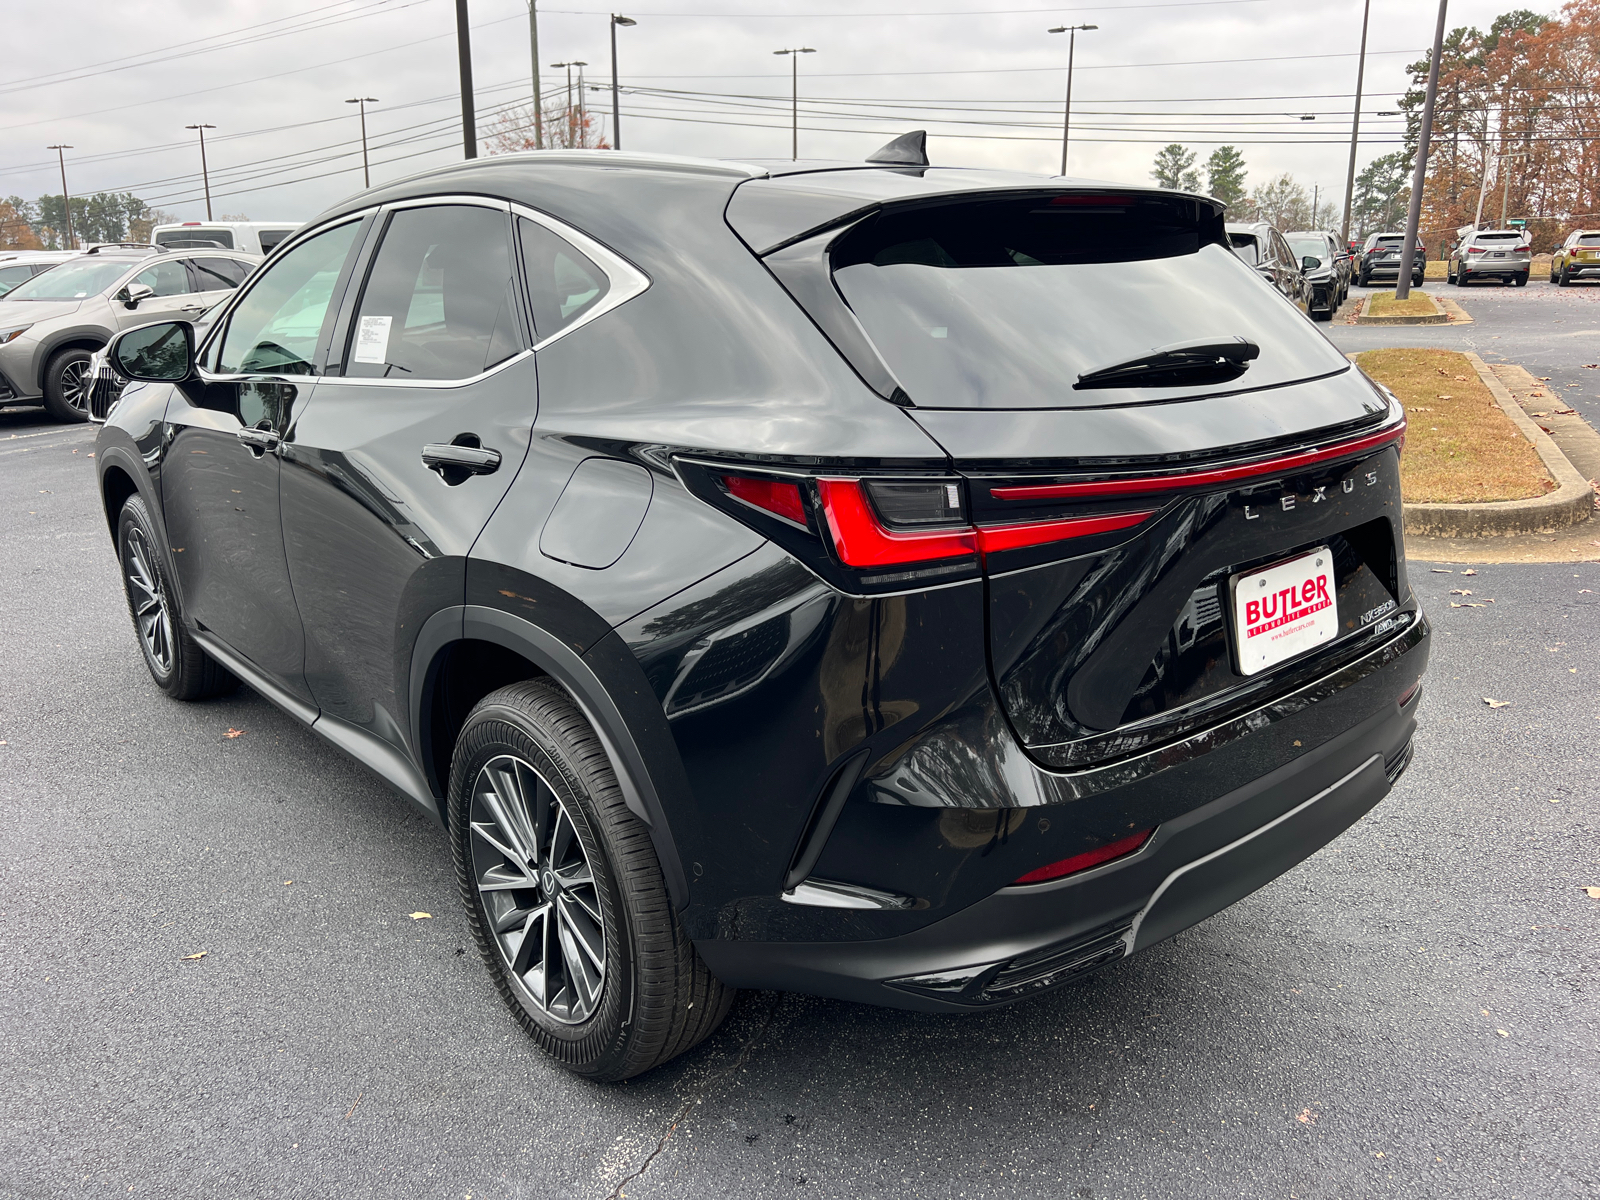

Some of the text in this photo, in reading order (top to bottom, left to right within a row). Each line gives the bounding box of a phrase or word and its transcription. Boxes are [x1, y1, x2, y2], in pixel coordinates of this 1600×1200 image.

[1244, 471, 1377, 520] LEXUS
[1247, 599, 1332, 638] AUTOMOTIVE GROUP
[1271, 620, 1315, 642] www.butlercars.com
